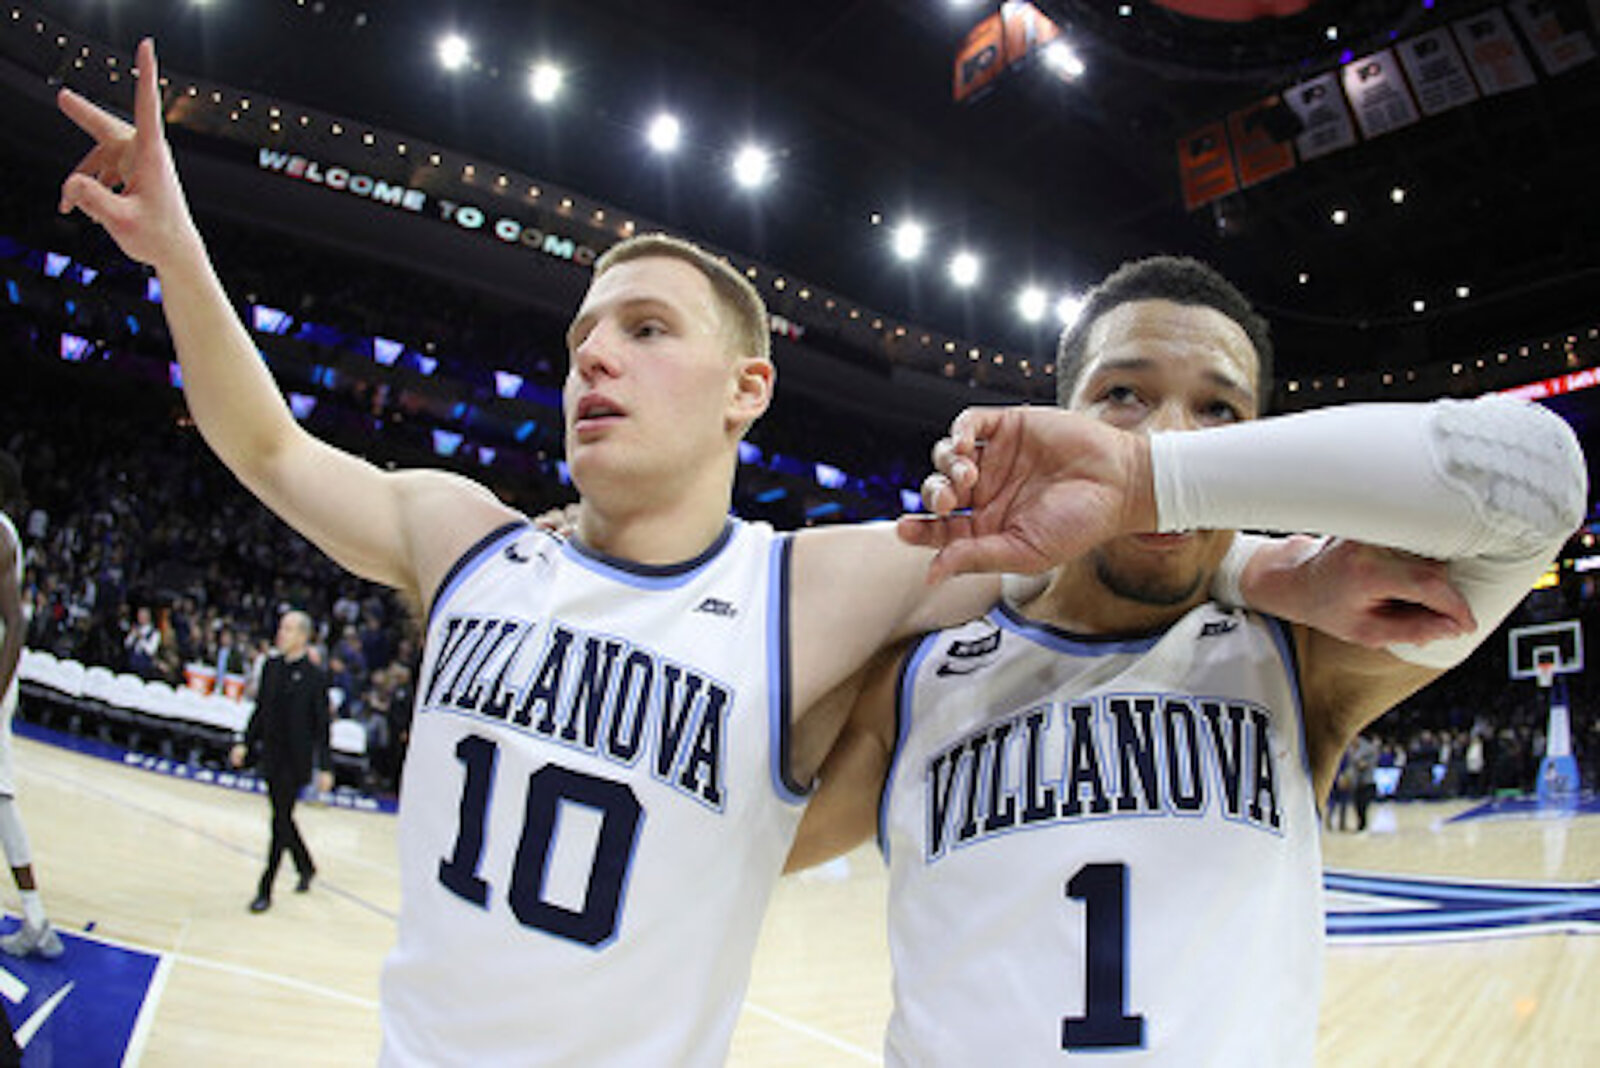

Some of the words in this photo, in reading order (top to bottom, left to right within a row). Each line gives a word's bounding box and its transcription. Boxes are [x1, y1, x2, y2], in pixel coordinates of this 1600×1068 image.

[257, 147, 427, 213] WELCOME
[439, 200, 486, 230] TO
[494, 217, 598, 266] COMC
[421, 613, 732, 813] VILLANOVA
[925, 692, 1284, 864] VILLANOVA
[438, 733, 647, 953] 10
[1061, 861, 1148, 1053] 1
